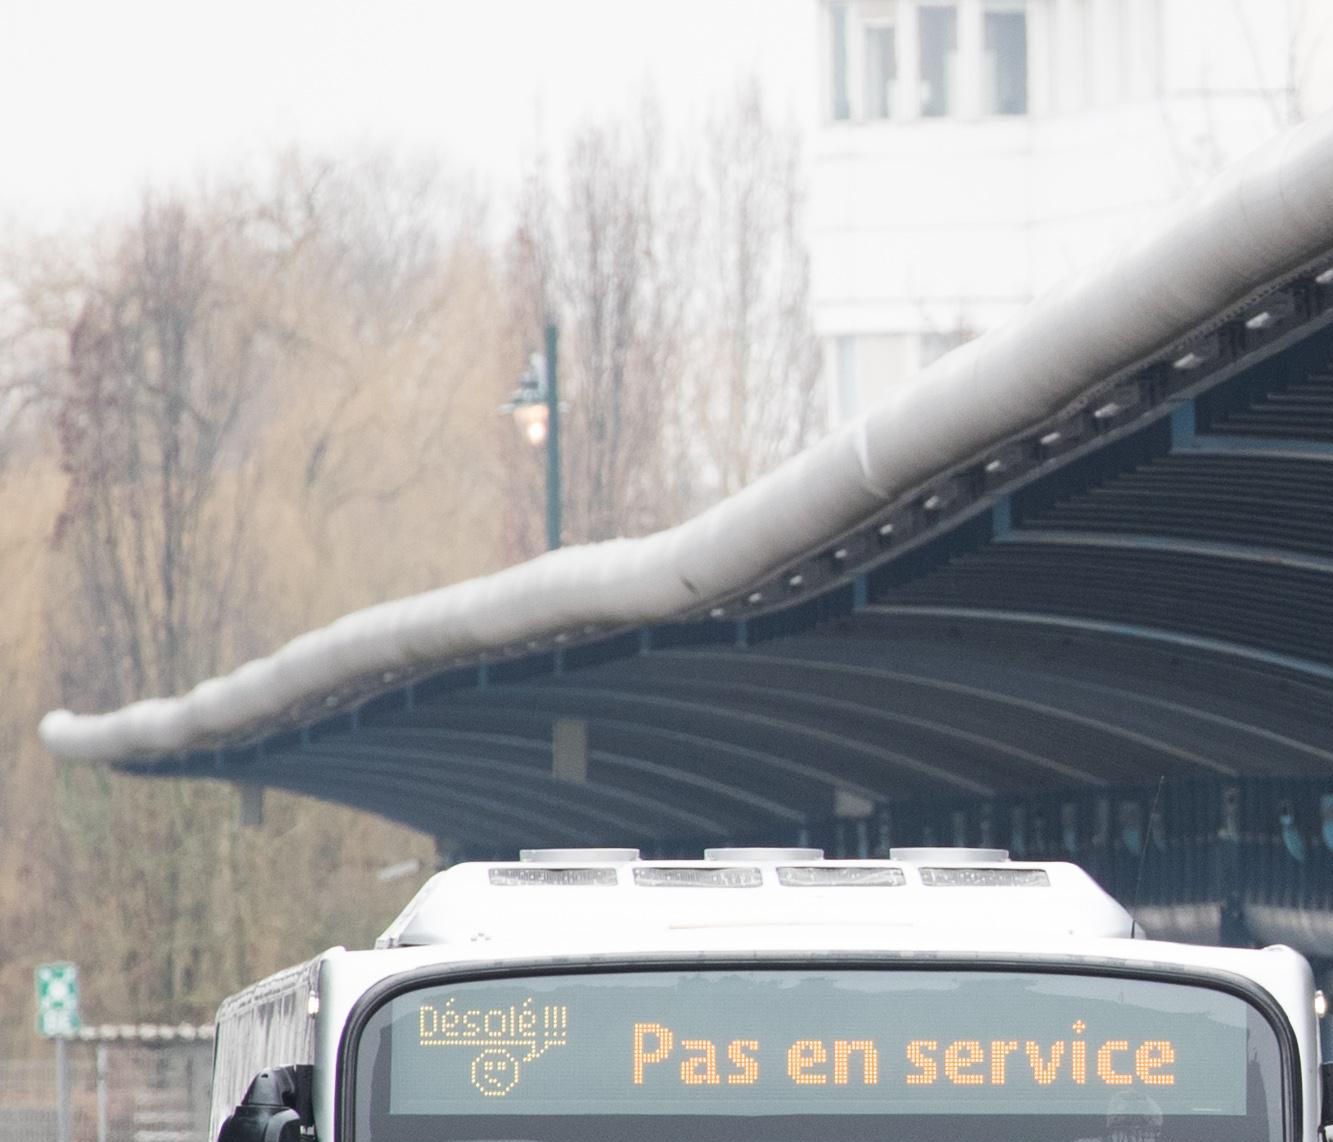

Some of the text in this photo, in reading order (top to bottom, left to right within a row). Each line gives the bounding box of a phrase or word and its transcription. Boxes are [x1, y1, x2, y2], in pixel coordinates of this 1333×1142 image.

[633, 1020, 1175, 1086] Pas en service
